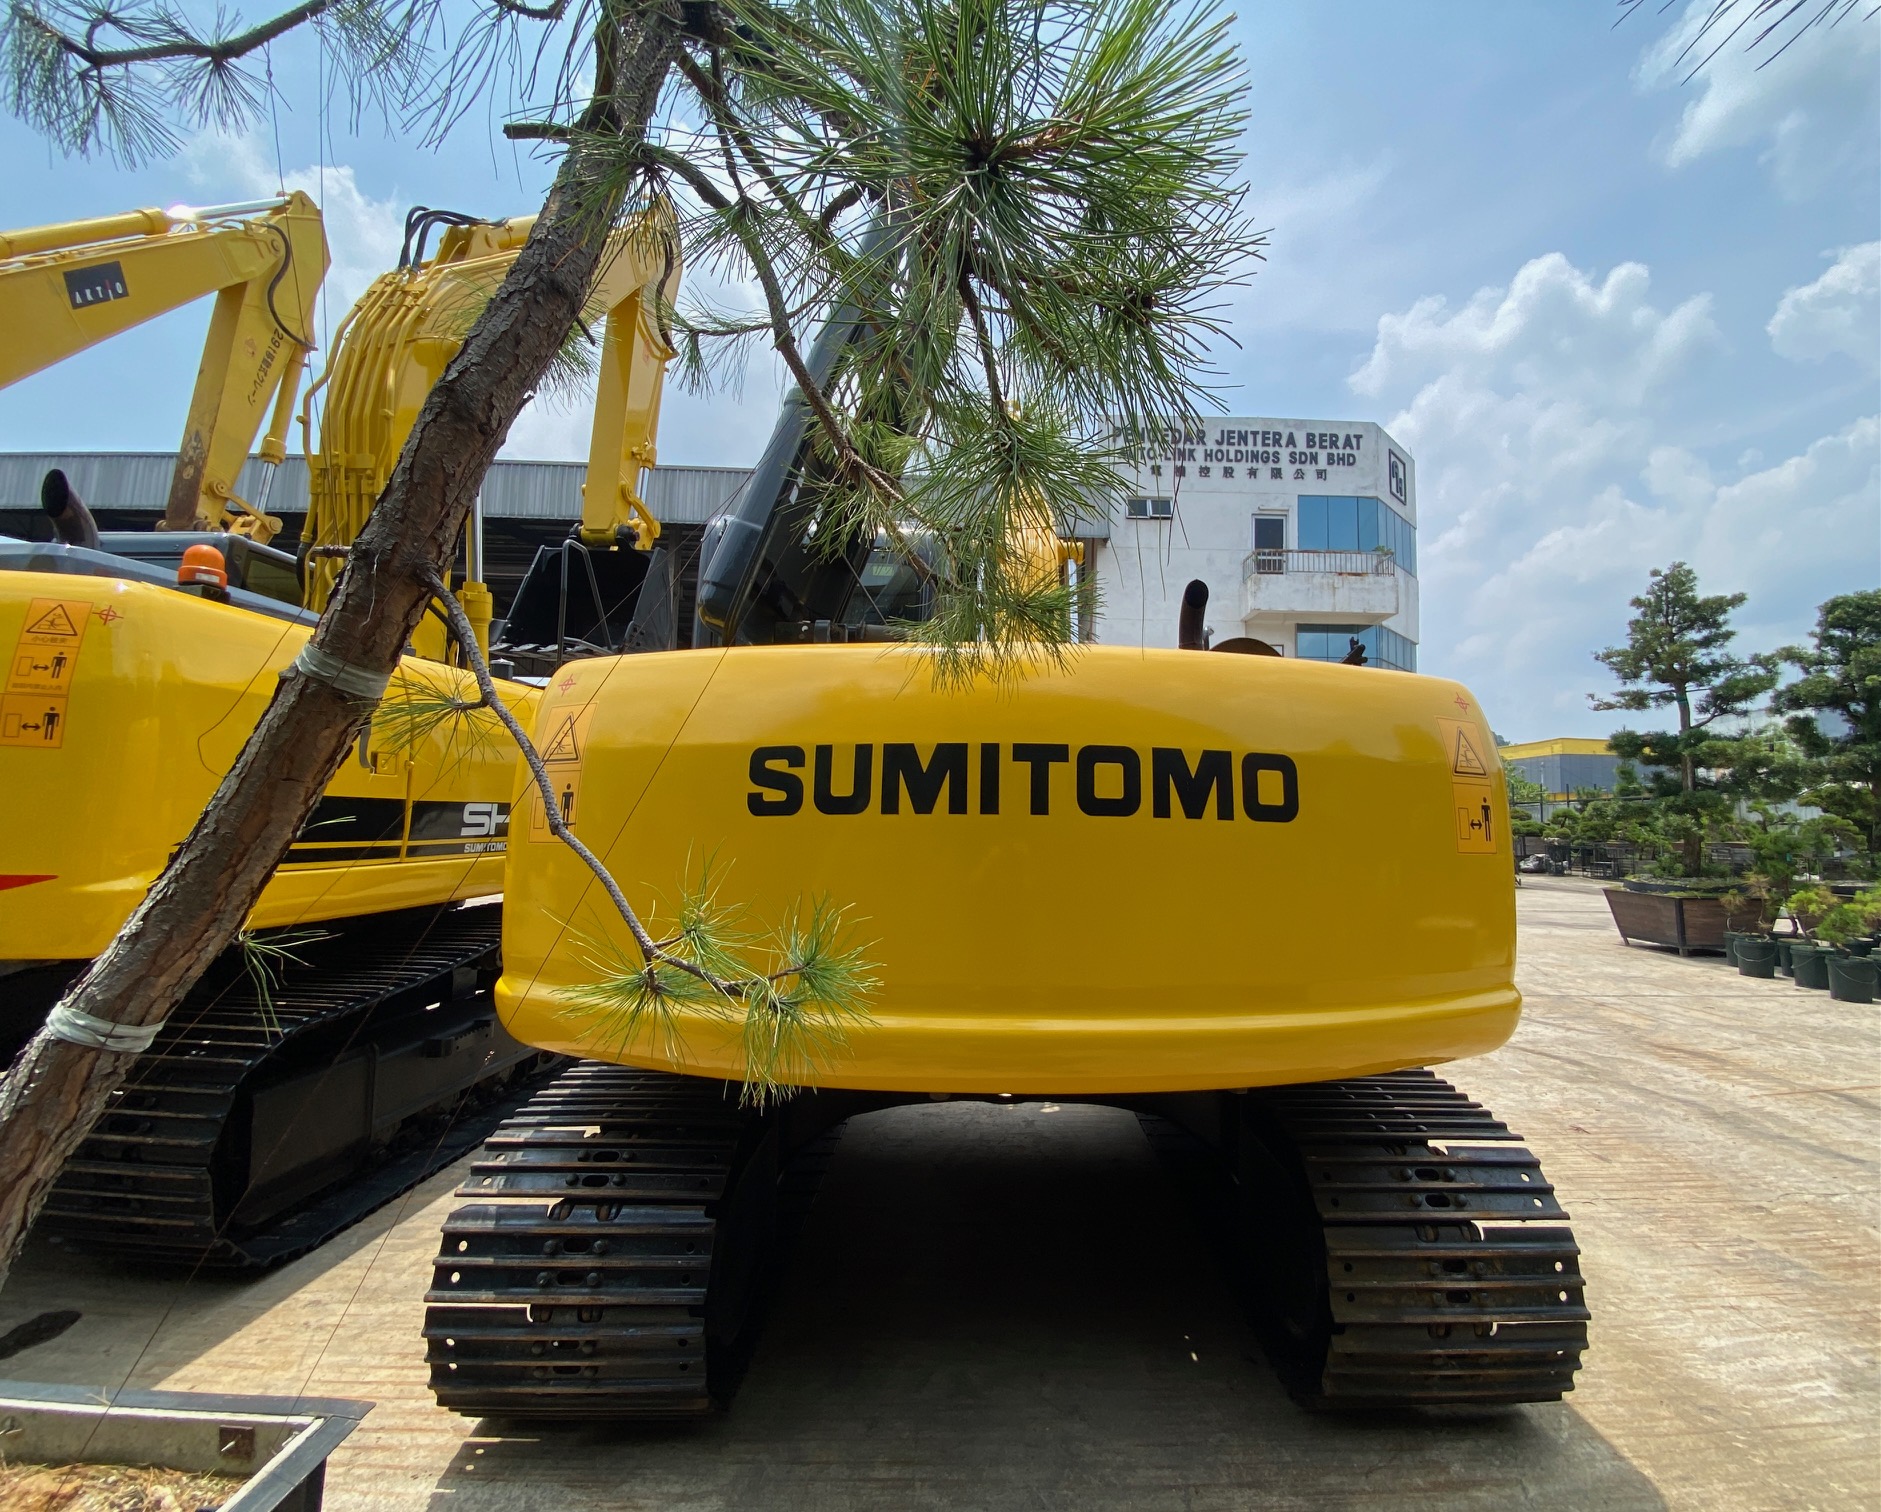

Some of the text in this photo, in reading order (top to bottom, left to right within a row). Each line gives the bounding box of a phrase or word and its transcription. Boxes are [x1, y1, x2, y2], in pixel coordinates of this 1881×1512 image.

[1215, 429, 1297, 448] JENTERA
[1306, 432, 1363, 450] BERAT
[1204, 448, 1281, 464] HOLDINGS
[1288, 451, 1319, 465] SDN
[1326, 452, 1356, 466] BHD
[747, 742, 1300, 823] SUMITOMO
